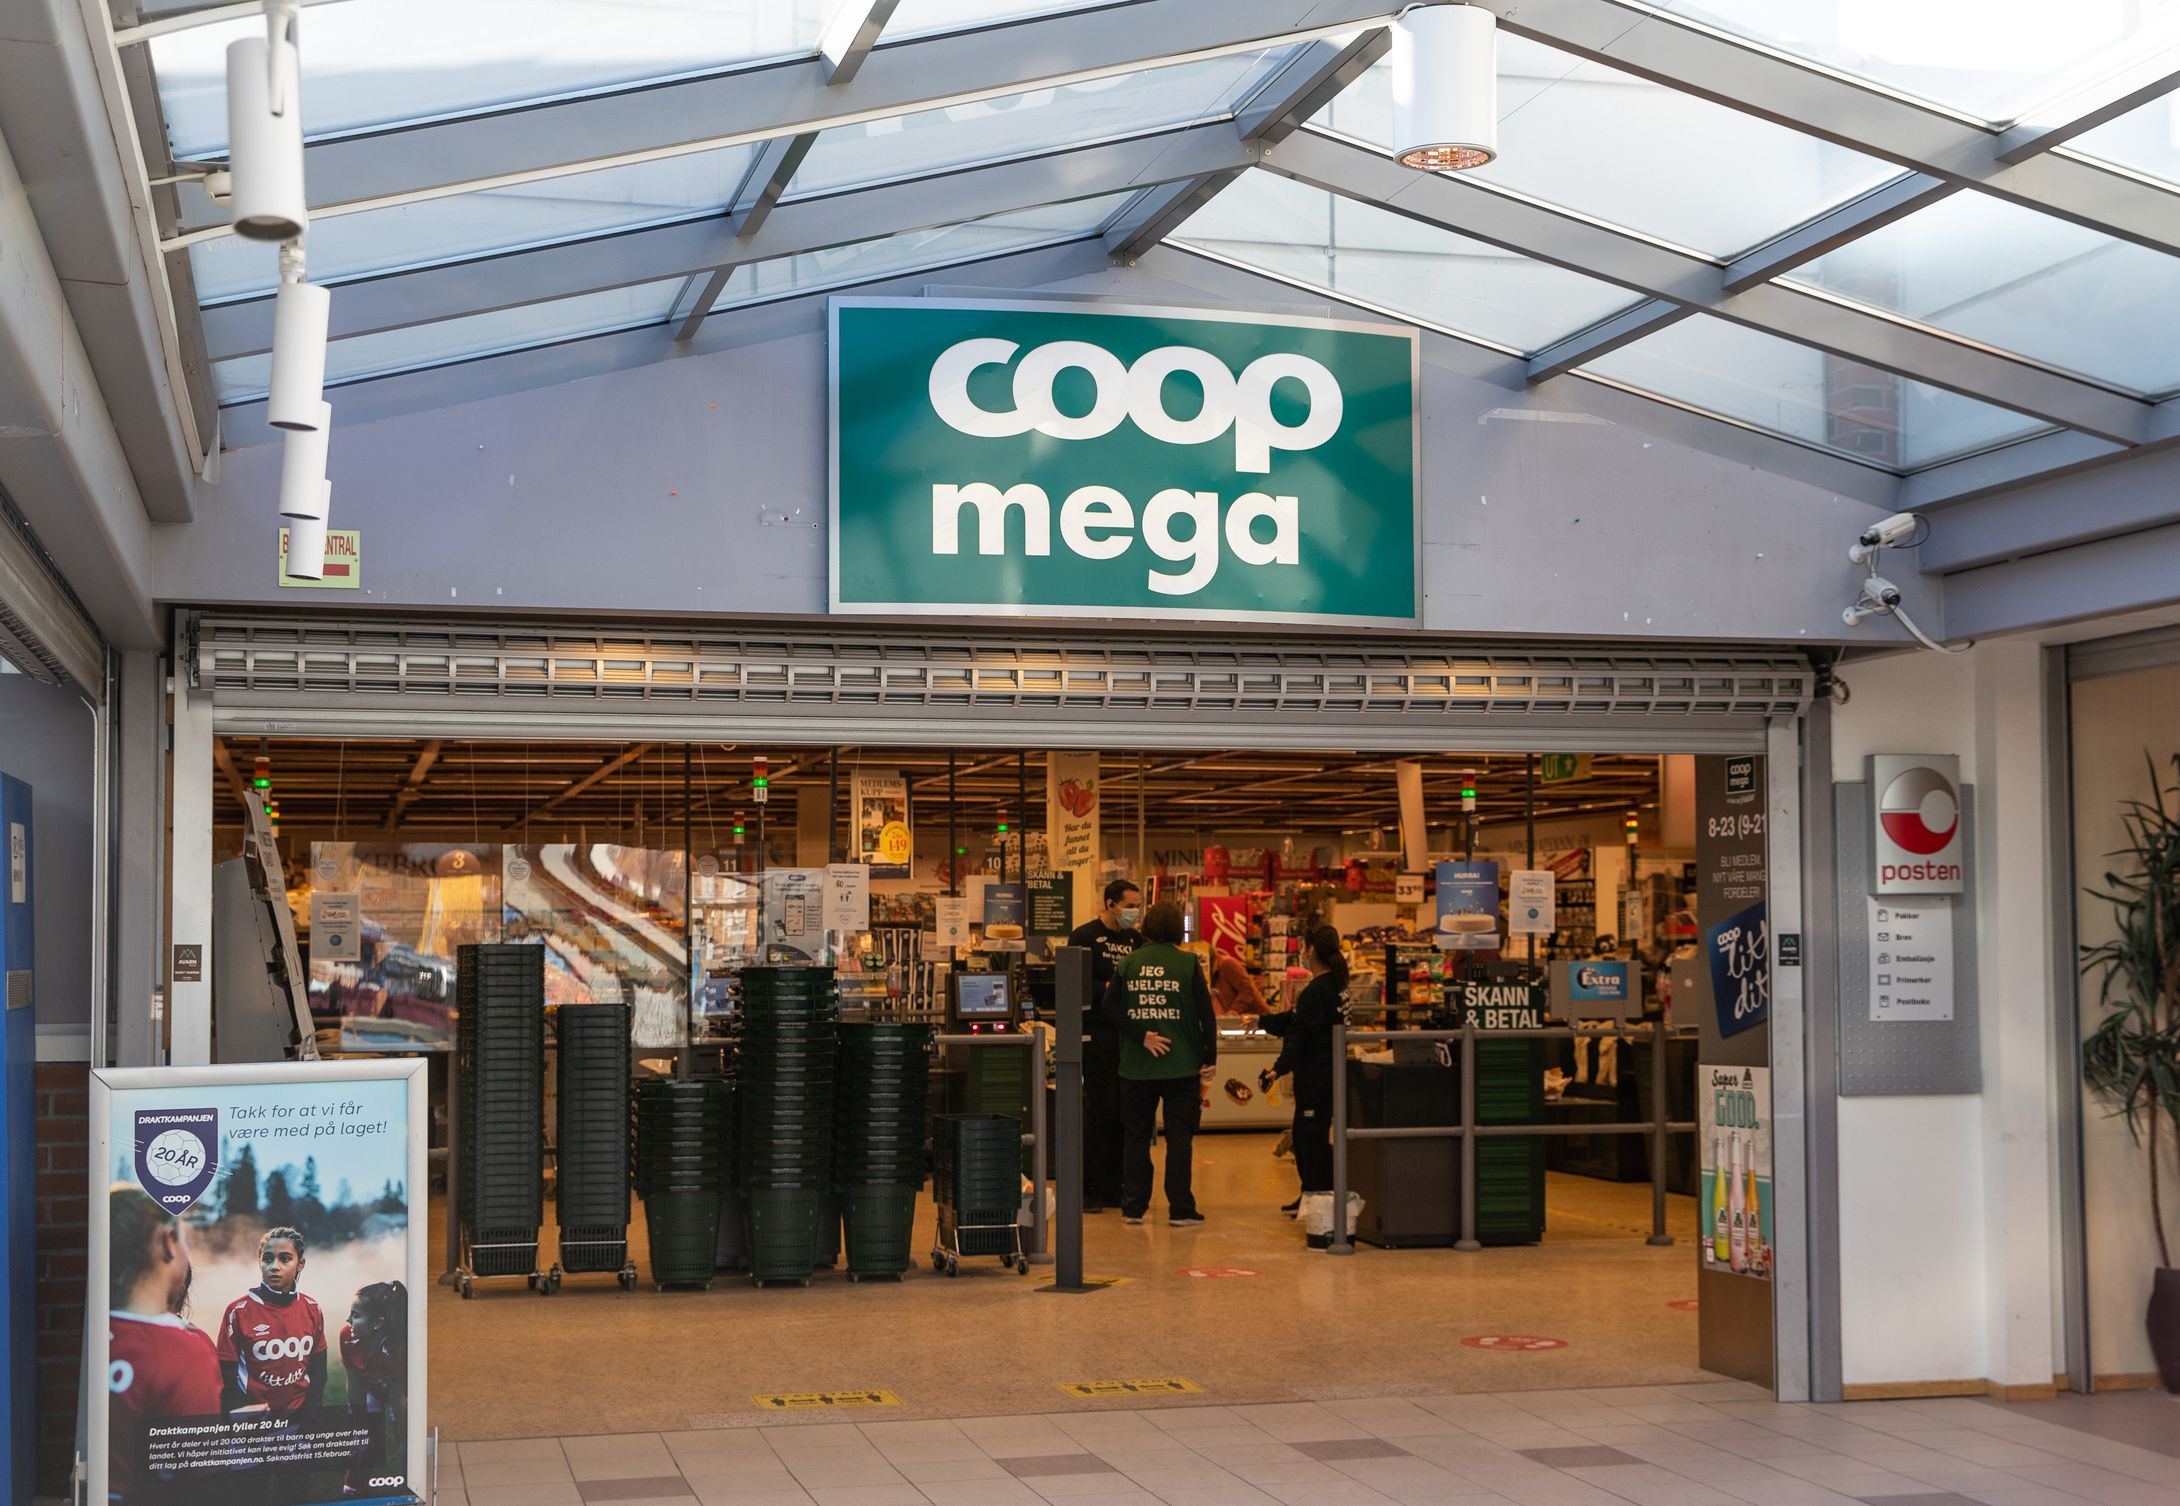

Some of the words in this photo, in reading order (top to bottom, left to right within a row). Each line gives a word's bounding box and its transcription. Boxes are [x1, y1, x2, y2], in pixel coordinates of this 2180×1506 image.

[928, 337, 1344, 474] coop
[931, 482, 1299, 596] mega
[1730, 763, 1751, 776] coop
[1708, 816, 1735, 838] 8-23
[1079, 845, 1089, 853] du
[452, 852, 465, 869] 3
[987, 857, 1001, 870] 10
[1027, 871, 1055, 880] SKANN
[1057, 871, 1064, 880] &
[1881, 860, 1961, 885] posten
[1027, 880, 1053, 889] BETAL
[1717, 926, 1741, 946] coop
[1139, 965, 1165, 977] JEG
[1582, 971, 1620, 986] Extra
[1126, 979, 1181, 993] HJELPER
[1138, 993, 1167, 1006] DEG
[1465, 986, 1529, 1007] SKANN
[1127, 1007, 1181, 1020] GJERNE!
[1465, 1009, 1480, 1029] &
[1485, 1009, 1543, 1029] BETAL
[138, 1113, 214, 1125] DRAKTKAMPANJEN
[229, 1106, 267, 1120] Takk
[271, 1104, 295, 1119] for
[299, 1105, 316, 1117] at
[321, 1101, 335, 1116] vi
[339, 1100, 364, 1116] får
[229, 1125, 269, 1139] være
[274, 1122, 310, 1137] med
[314, 1121, 336, 1138] på
[340, 1120, 388, 1137] laget!
[154, 1146, 175, 1162] 20
[174, 1144, 199, 1169] ÅR
[162, 1194, 191, 1204] coop
[252, 1335, 314, 1362] coop
[259, 1370, 284, 1387] litt
[284, 1368, 305, 1386] ditt
[149, 1423, 230, 1436] Draktkampanjen
[232, 1421, 258, 1432] fyller
[260, 1420, 272, 1429] 20
[274, 1418, 288, 1428] år!
[171, 1441, 181, 1449] år
[182, 1440, 201, 1448] deler
[203, 1439, 210, 1447] vi
[220, 1438, 230, 1446] 20
[231, 1437, 246, 1445] 000
[247, 1435, 275, 1443] drakter
[277, 1433, 285, 1441] til
[286, 1432, 304, 1440] barn
[305, 1432, 315, 1441] og
[316, 1431, 334, 1440] unge
[336, 1430, 351, 1438] over
[149, 1452, 176, 1460] landet.
[177, 1451, 185, 1459] Vi
[186, 1449, 209, 1459] håper
[210, 1447, 246, 1457] initiativet
[247, 1446, 261, 1454] kan
[262, 1445, 277, 1453] leve
[279, 1443, 297, 1453] evig!
[298, 1442, 311, 1450] Søk
[326, 1440, 360, 1449] draktsett
[361, 1438, 369, 1446] til
[149, 1463, 163, 1471] ditt
[164, 1461, 177, 1470] lag
[178, 1460, 189, 1469] på
[190, 1456, 265, 1468] draktkampanjen.no.
[266, 1452, 313, 1462] Søknadsfrist
[368, 1475, 405, 1487] coop
